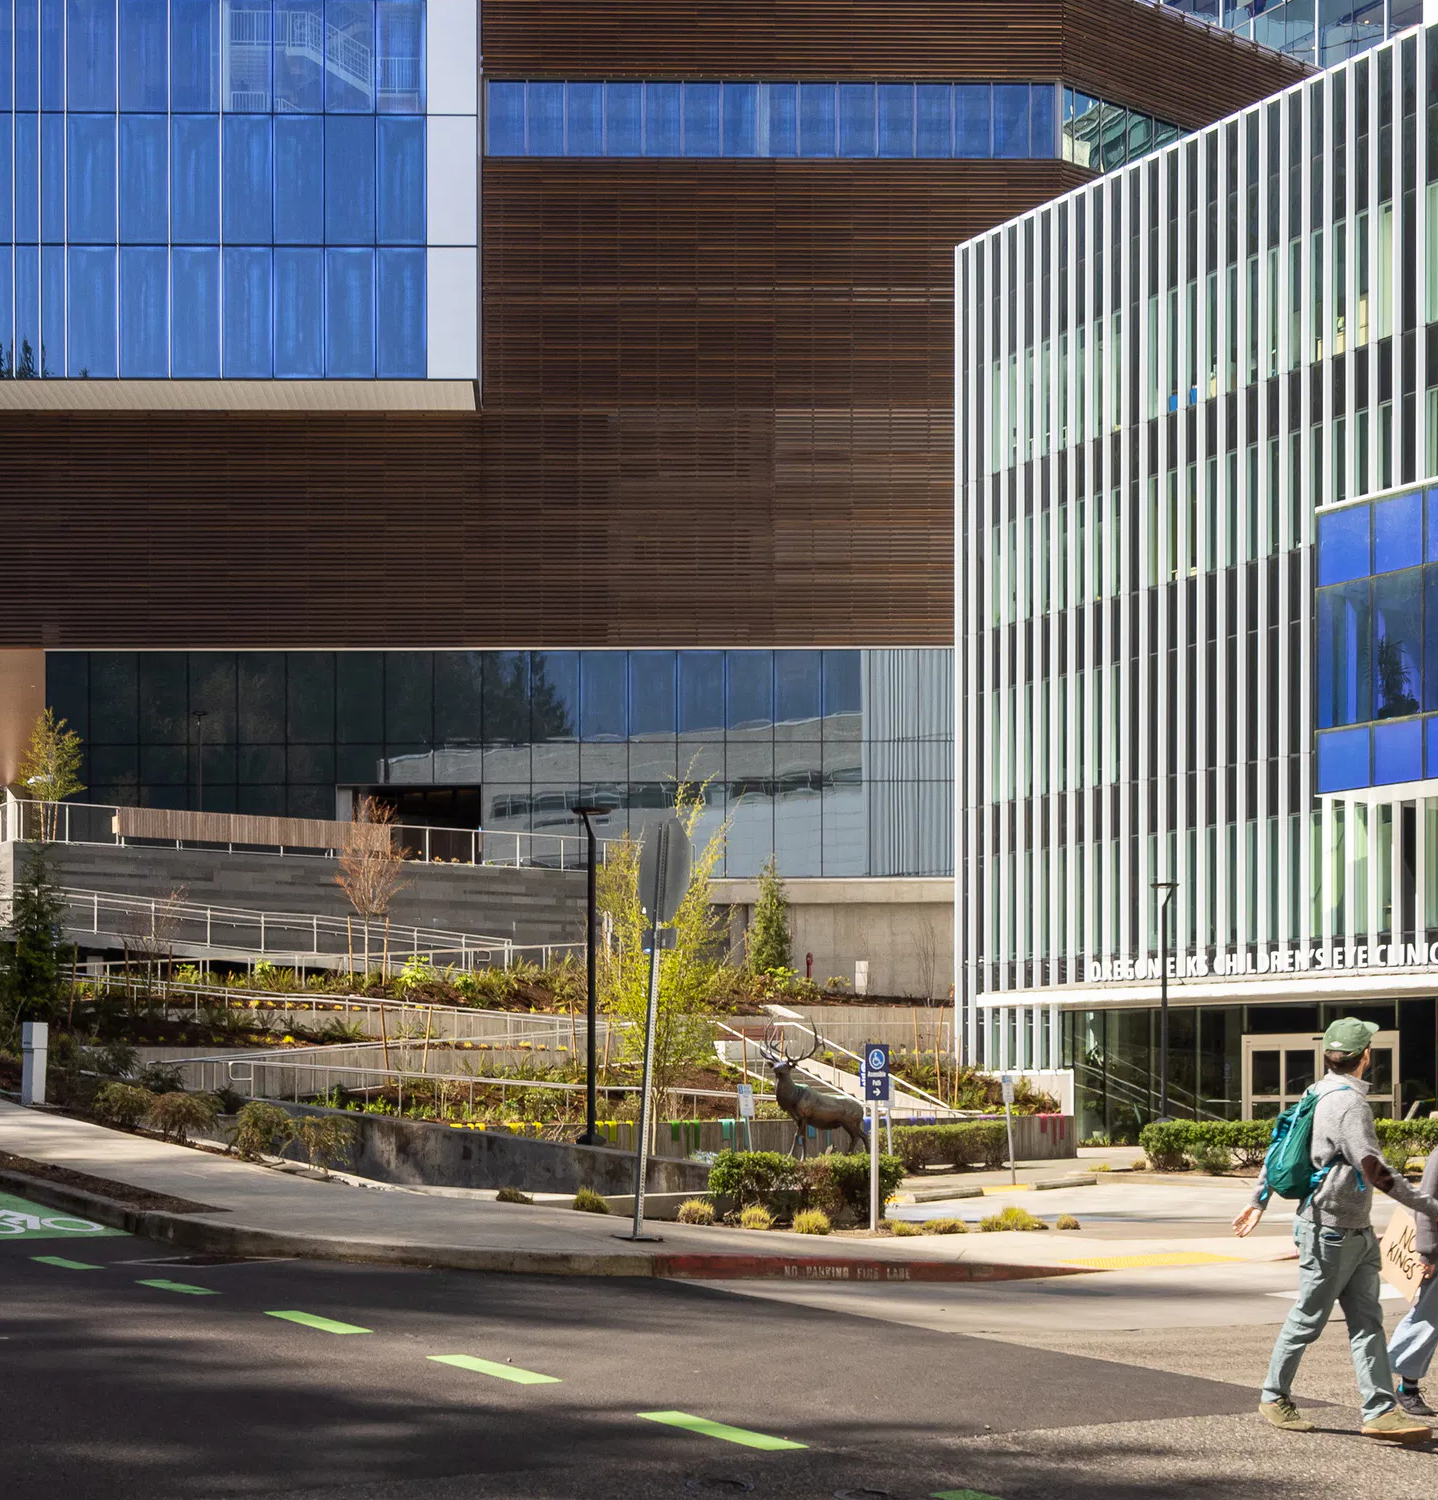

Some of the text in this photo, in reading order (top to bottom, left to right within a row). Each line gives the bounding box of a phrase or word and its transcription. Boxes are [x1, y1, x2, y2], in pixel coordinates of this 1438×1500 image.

[1090, 958, 1162, 982] OREGON
[1166, 955, 1209, 978] ELKS
[1213, 947, 1326, 976] CHILDREN'S
[1333, 945, 1368, 969] EYE
[784, 1265, 911, 1280] NO PARKING FIRE LANE
[1386, 1241, 1417, 1281] KINGS
